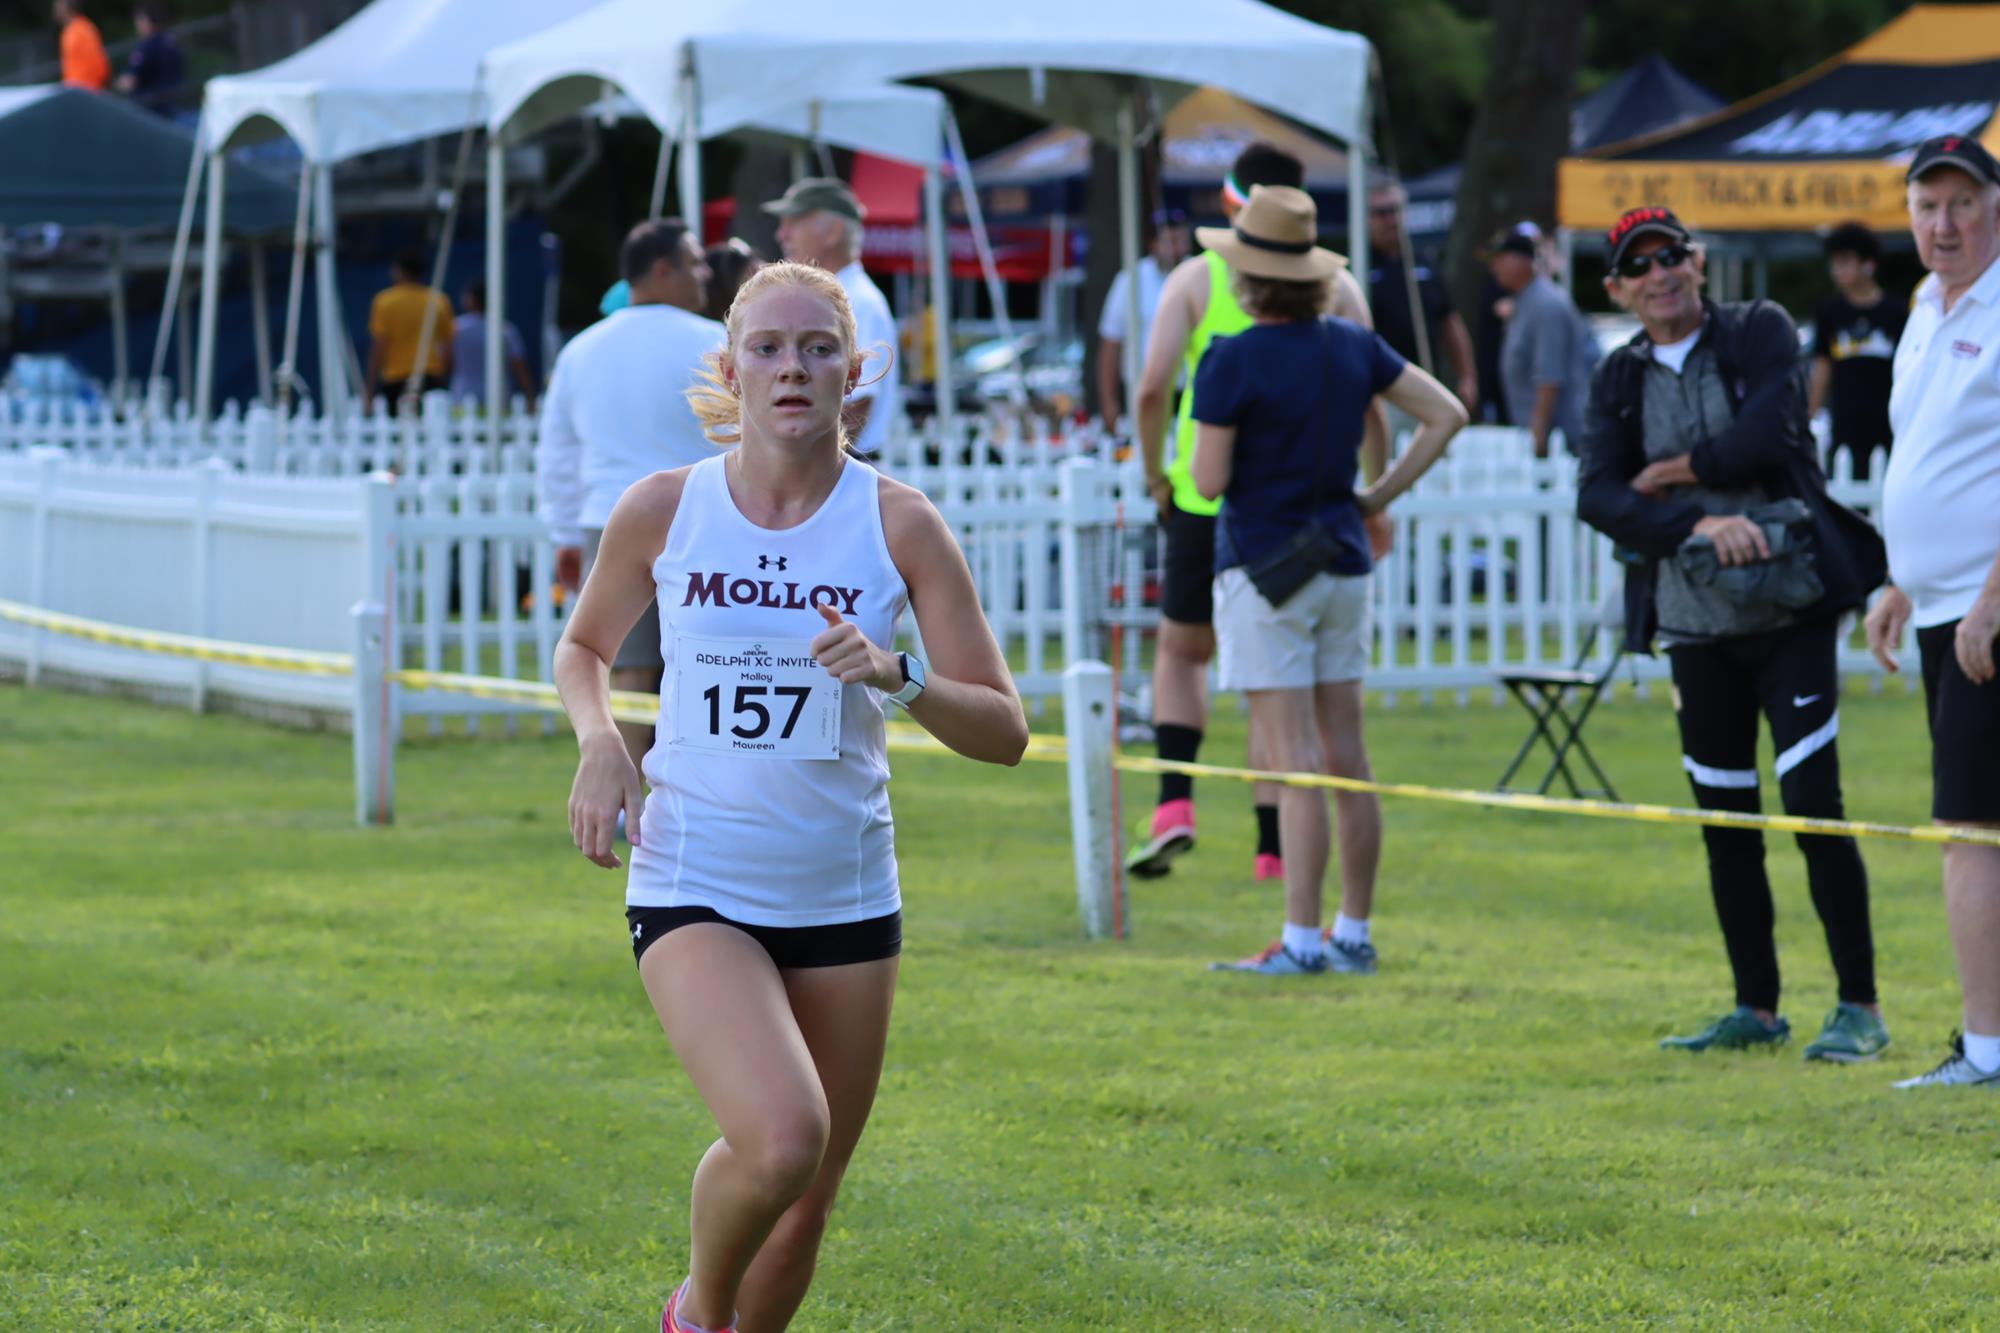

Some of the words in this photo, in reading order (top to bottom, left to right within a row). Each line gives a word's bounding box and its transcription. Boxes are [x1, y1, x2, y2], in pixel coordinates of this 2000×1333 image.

[681, 572, 864, 616] MOLLOY
[696, 653, 751, 666] ADELPHI
[755, 657, 773, 668] XC
[777, 657, 817, 668] INVITE
[741, 672, 773, 683] Molloy
[703, 684, 813, 739] 157
[732, 740, 775, 750] Maureen
